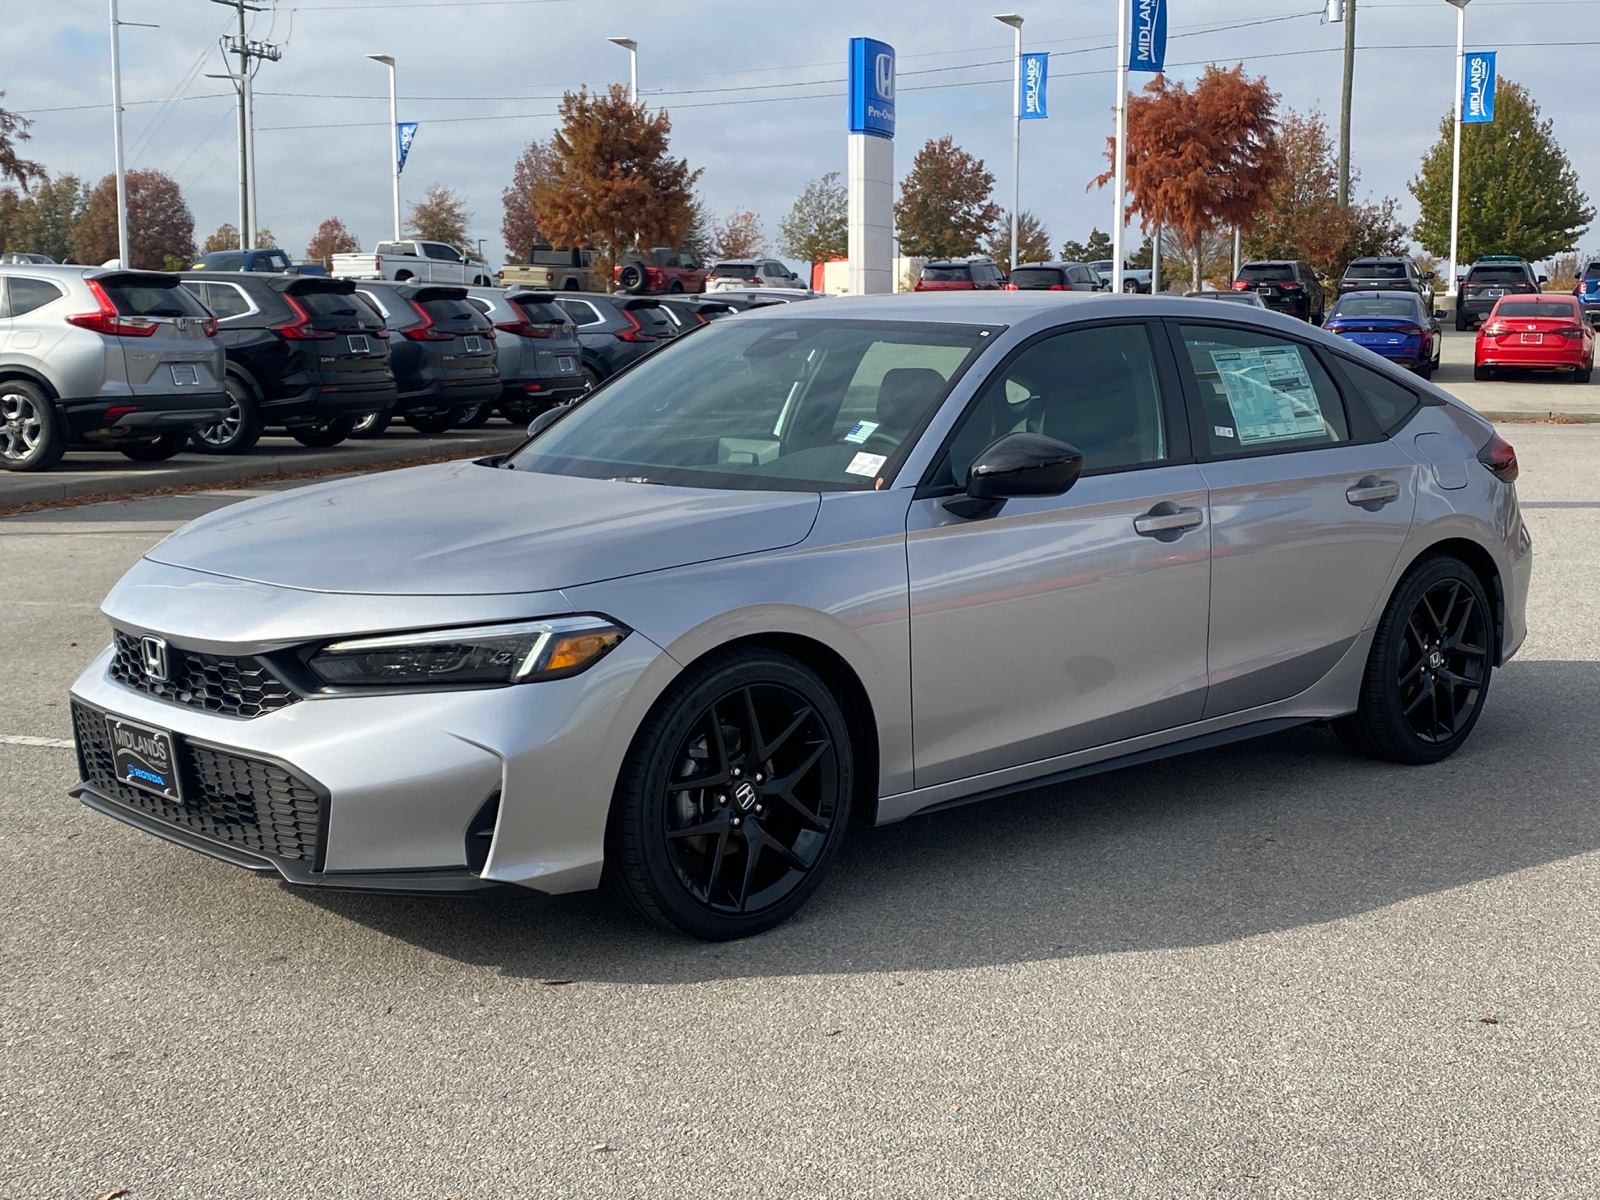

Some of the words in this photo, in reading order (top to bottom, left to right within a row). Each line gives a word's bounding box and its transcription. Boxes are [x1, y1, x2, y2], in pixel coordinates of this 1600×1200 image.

[1026, 58, 1036, 112] MIDLANDS
[1470, 58, 1481, 115] MIDLANDS
[113, 727, 166, 760] MIDLANDS
[135, 768, 165, 785] HONDA
